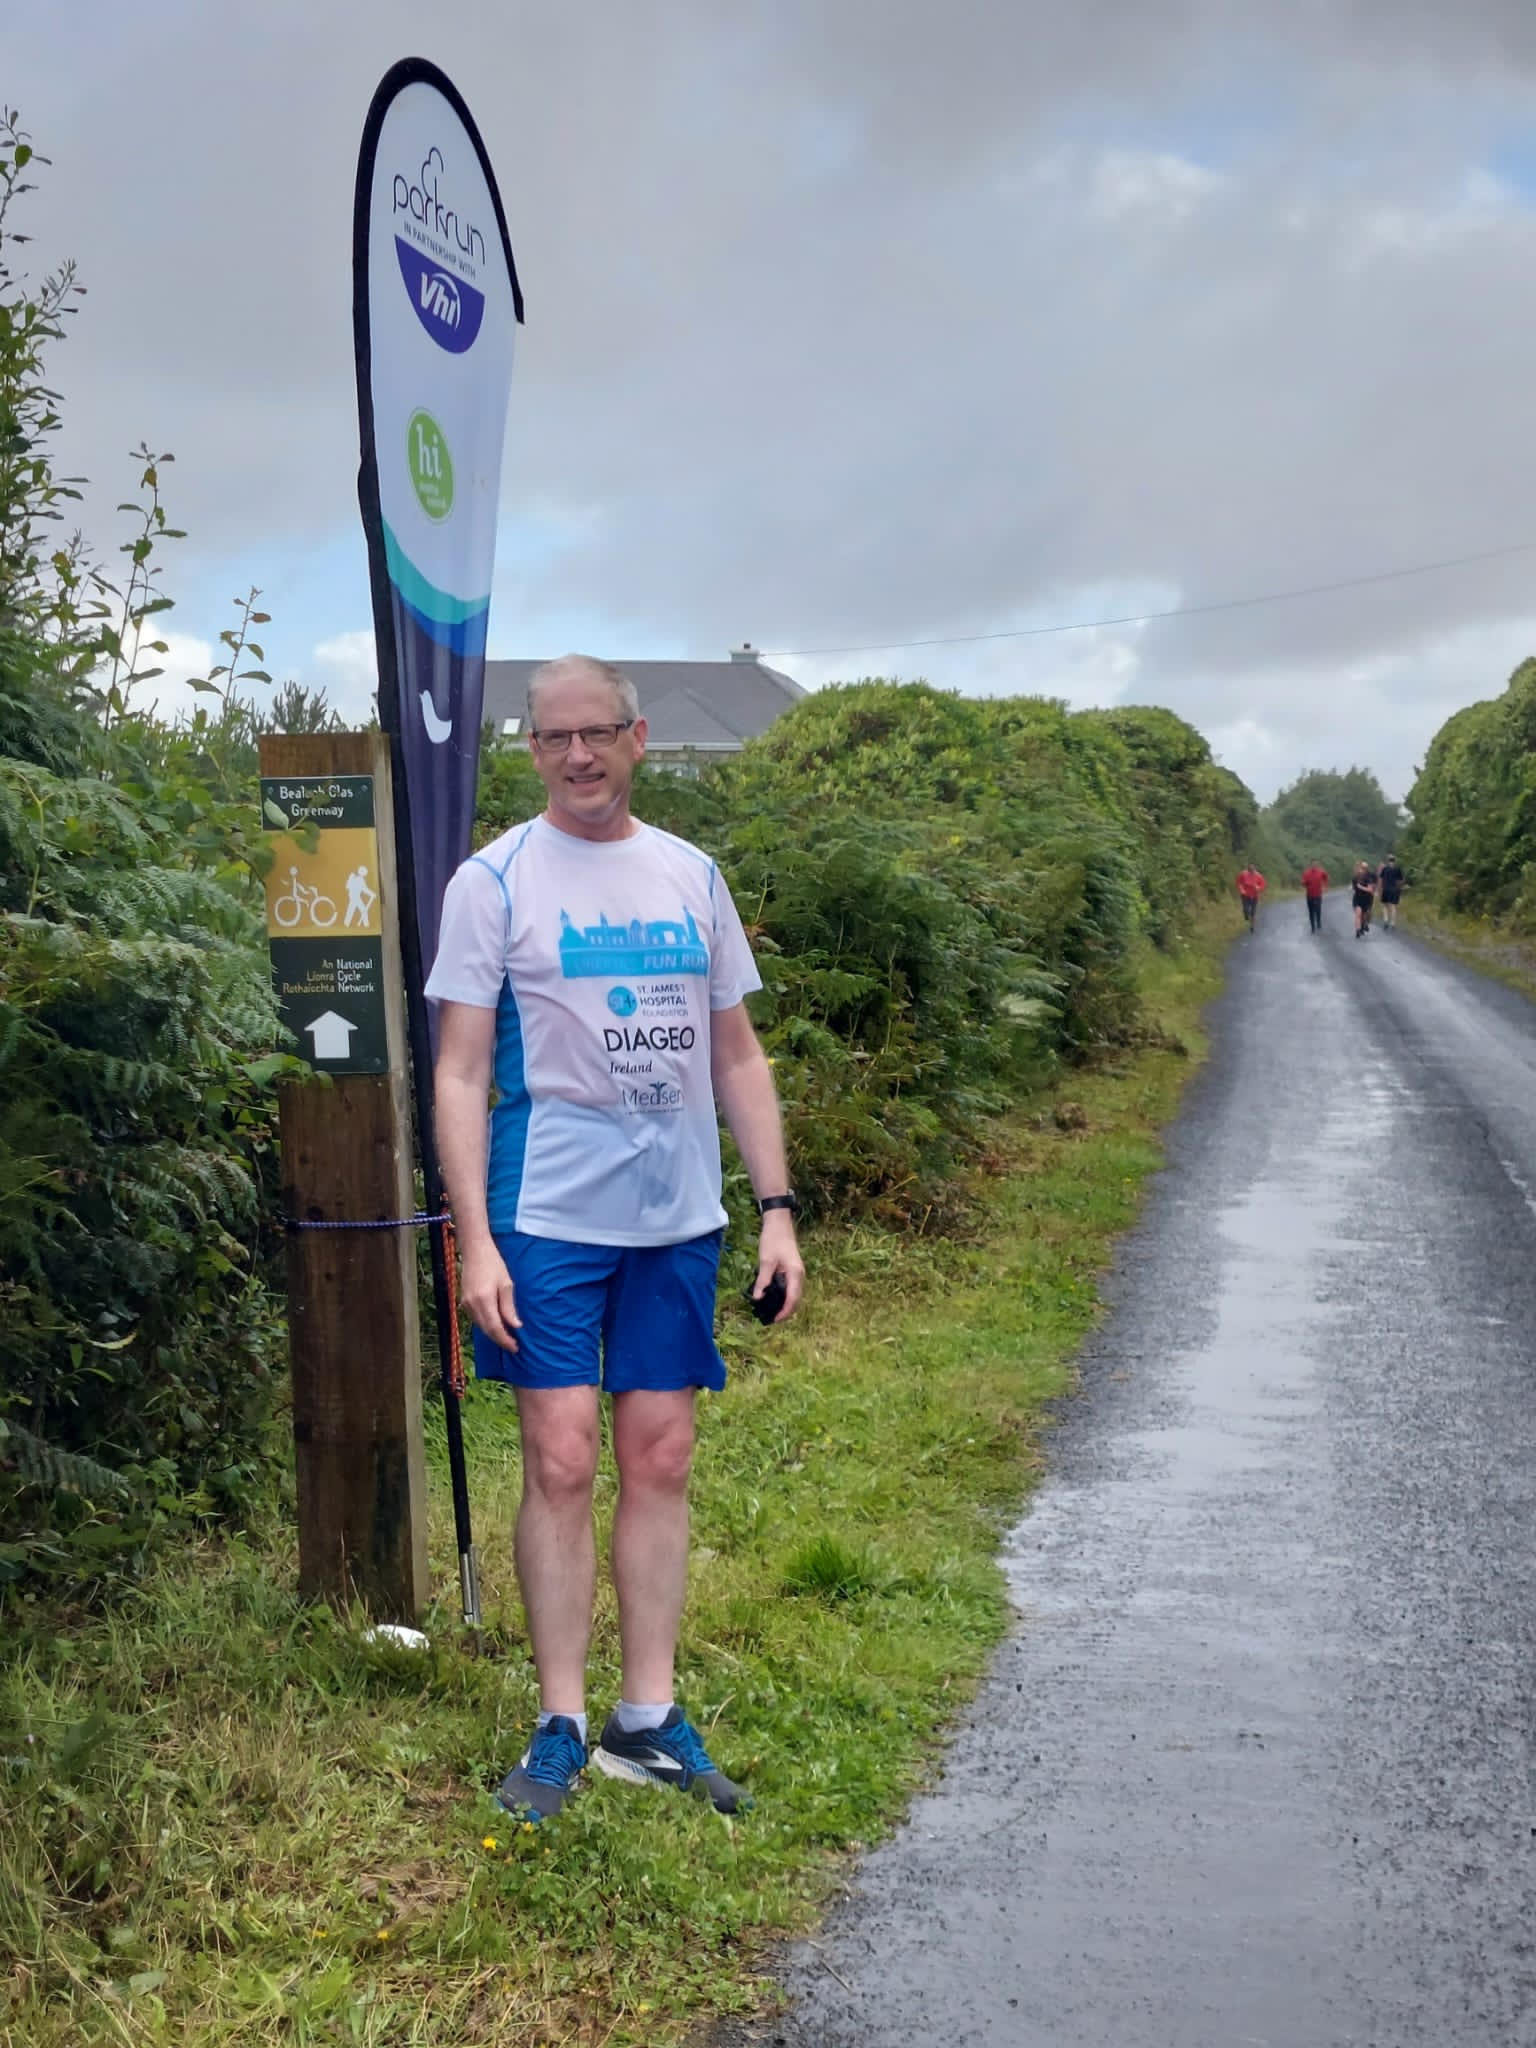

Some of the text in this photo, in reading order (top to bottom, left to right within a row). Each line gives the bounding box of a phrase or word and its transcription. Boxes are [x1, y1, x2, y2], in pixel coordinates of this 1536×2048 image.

[393, 147, 485, 265] parkrun
[416, 424, 441, 479] hi
[279, 785, 325, 800] Bealh
[336, 958, 373, 970] National
[337, 969, 361, 983] Cycle
[337, 982, 375, 993] Network
[640, 994, 688, 1007] HOSPITAL
[603, 1026, 695, 1052] DIAGEO
[610, 1060, 653, 1074] Ireland
